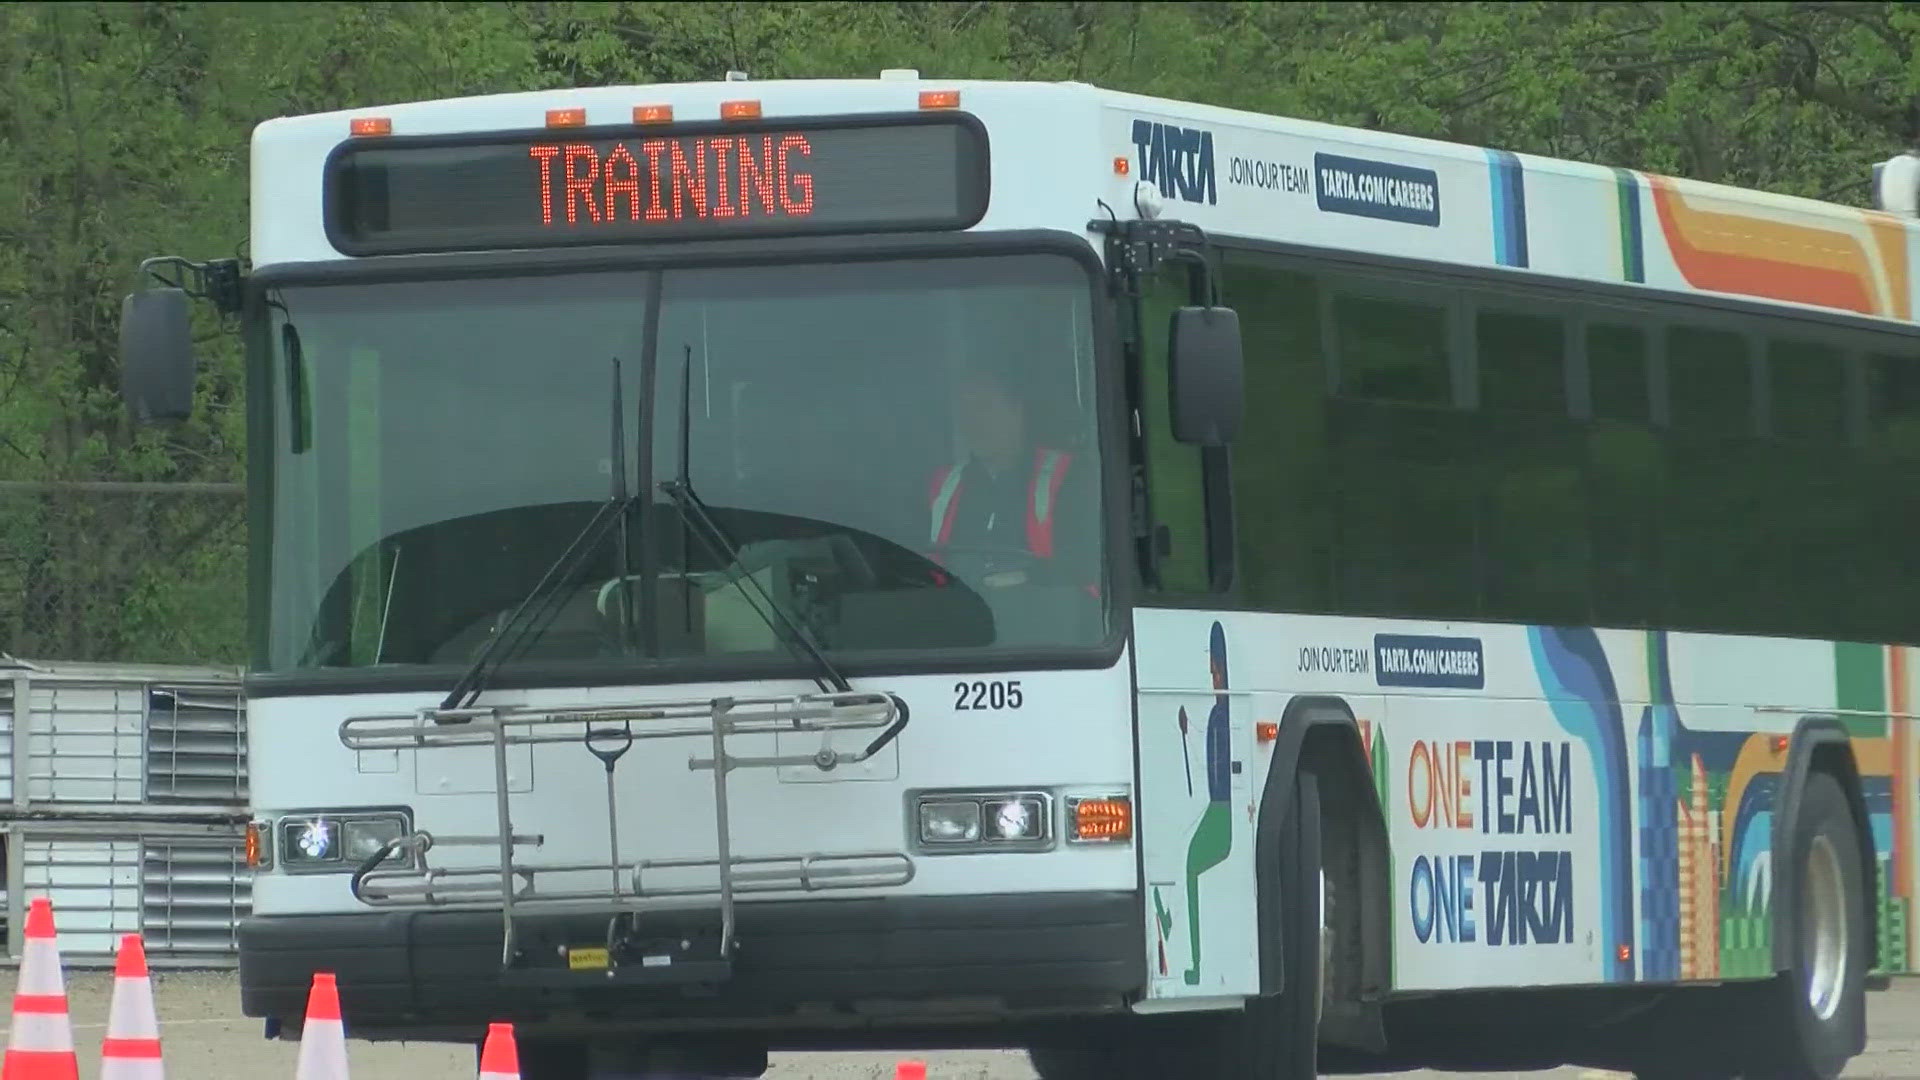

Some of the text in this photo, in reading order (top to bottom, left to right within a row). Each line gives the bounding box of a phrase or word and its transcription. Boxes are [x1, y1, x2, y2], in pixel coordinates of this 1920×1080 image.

[529, 135, 813, 224] TRAINING
[1132, 119, 1217, 206] TARTA
[1229, 157, 1310, 194] JOIN OUR TEAM
[1321, 168, 1435, 212] TARTA.COM/CAREERS
[1298, 647, 1370, 674] JOIN OUR TEAM
[1380, 647, 1479, 676] TARTA.COM/CAREERS
[954, 681, 1023, 710] 2205
[1410, 851, 1574, 946] ONE TARTA
